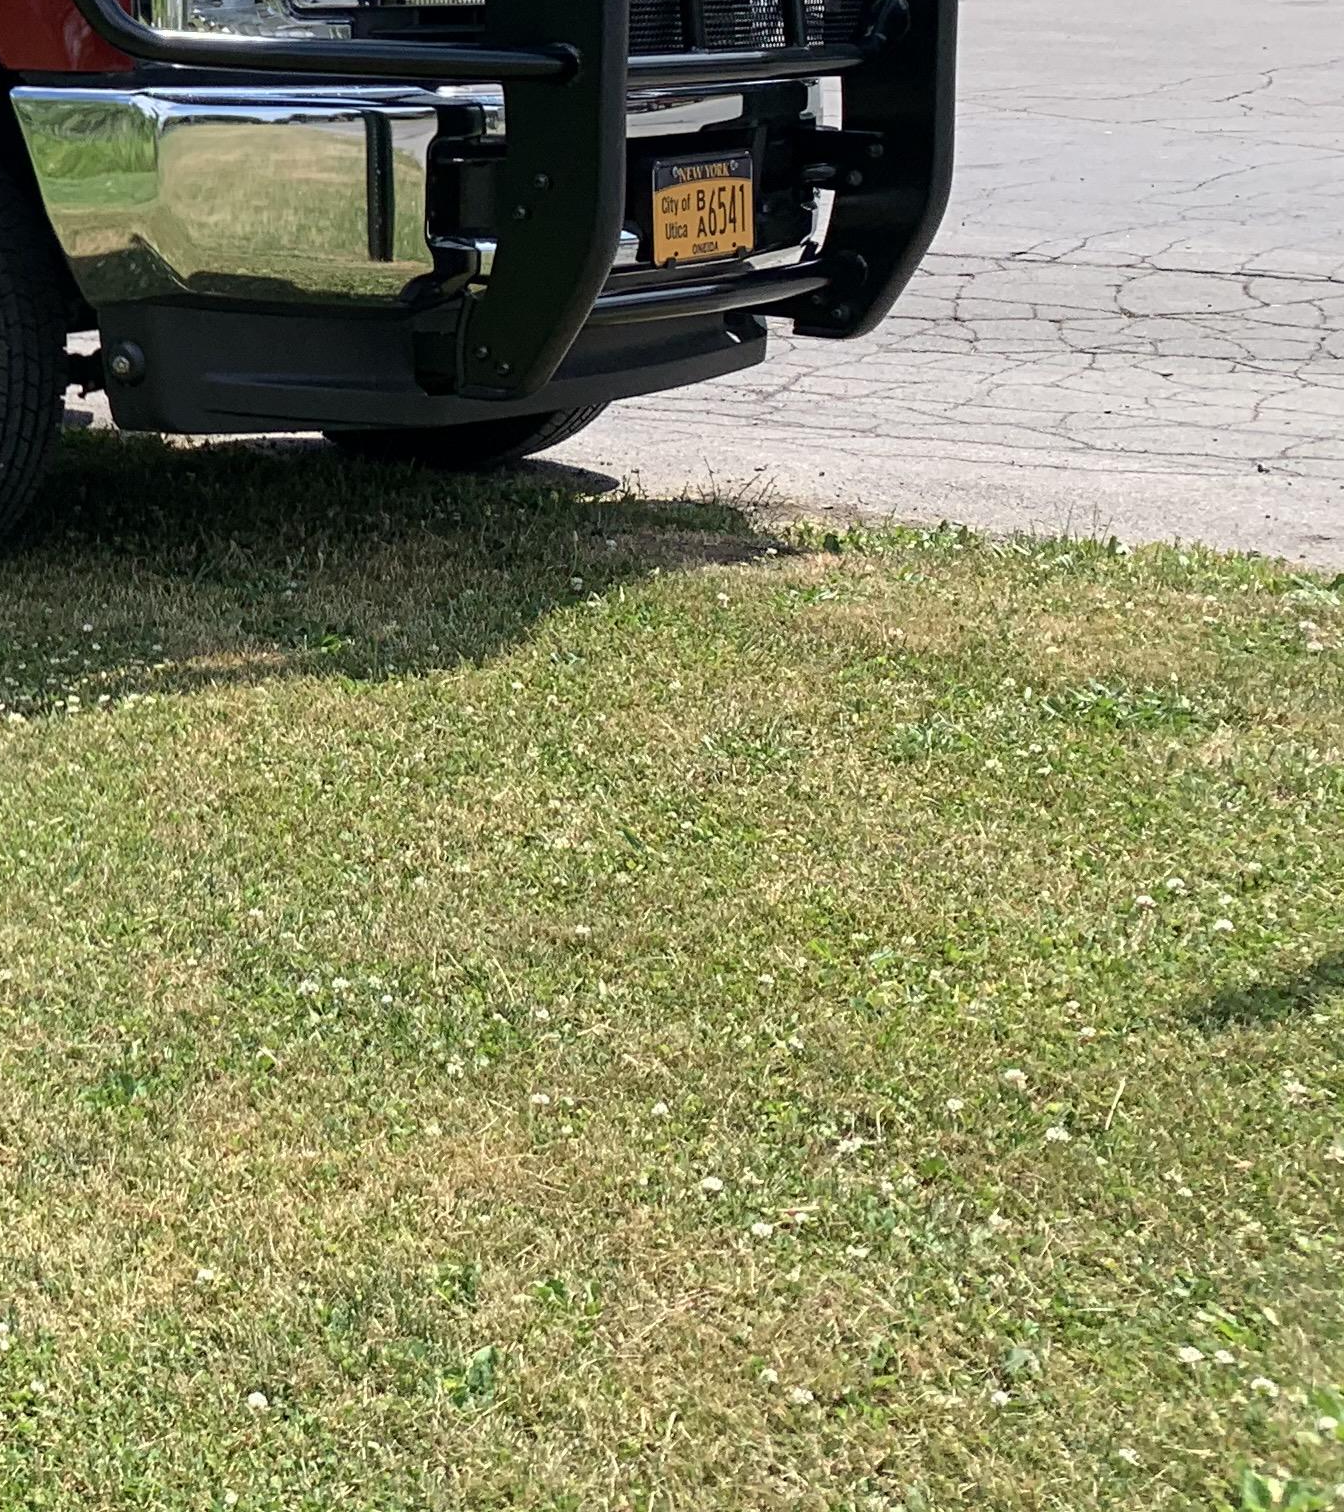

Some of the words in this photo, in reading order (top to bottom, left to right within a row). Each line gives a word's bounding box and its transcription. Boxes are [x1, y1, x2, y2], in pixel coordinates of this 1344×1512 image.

[678, 166, 703, 183] NEW
[704, 162, 731, 179] YORK
[661, 196, 679, 216] City
[681, 193, 691, 212] of
[665, 223, 688, 240] Utica
